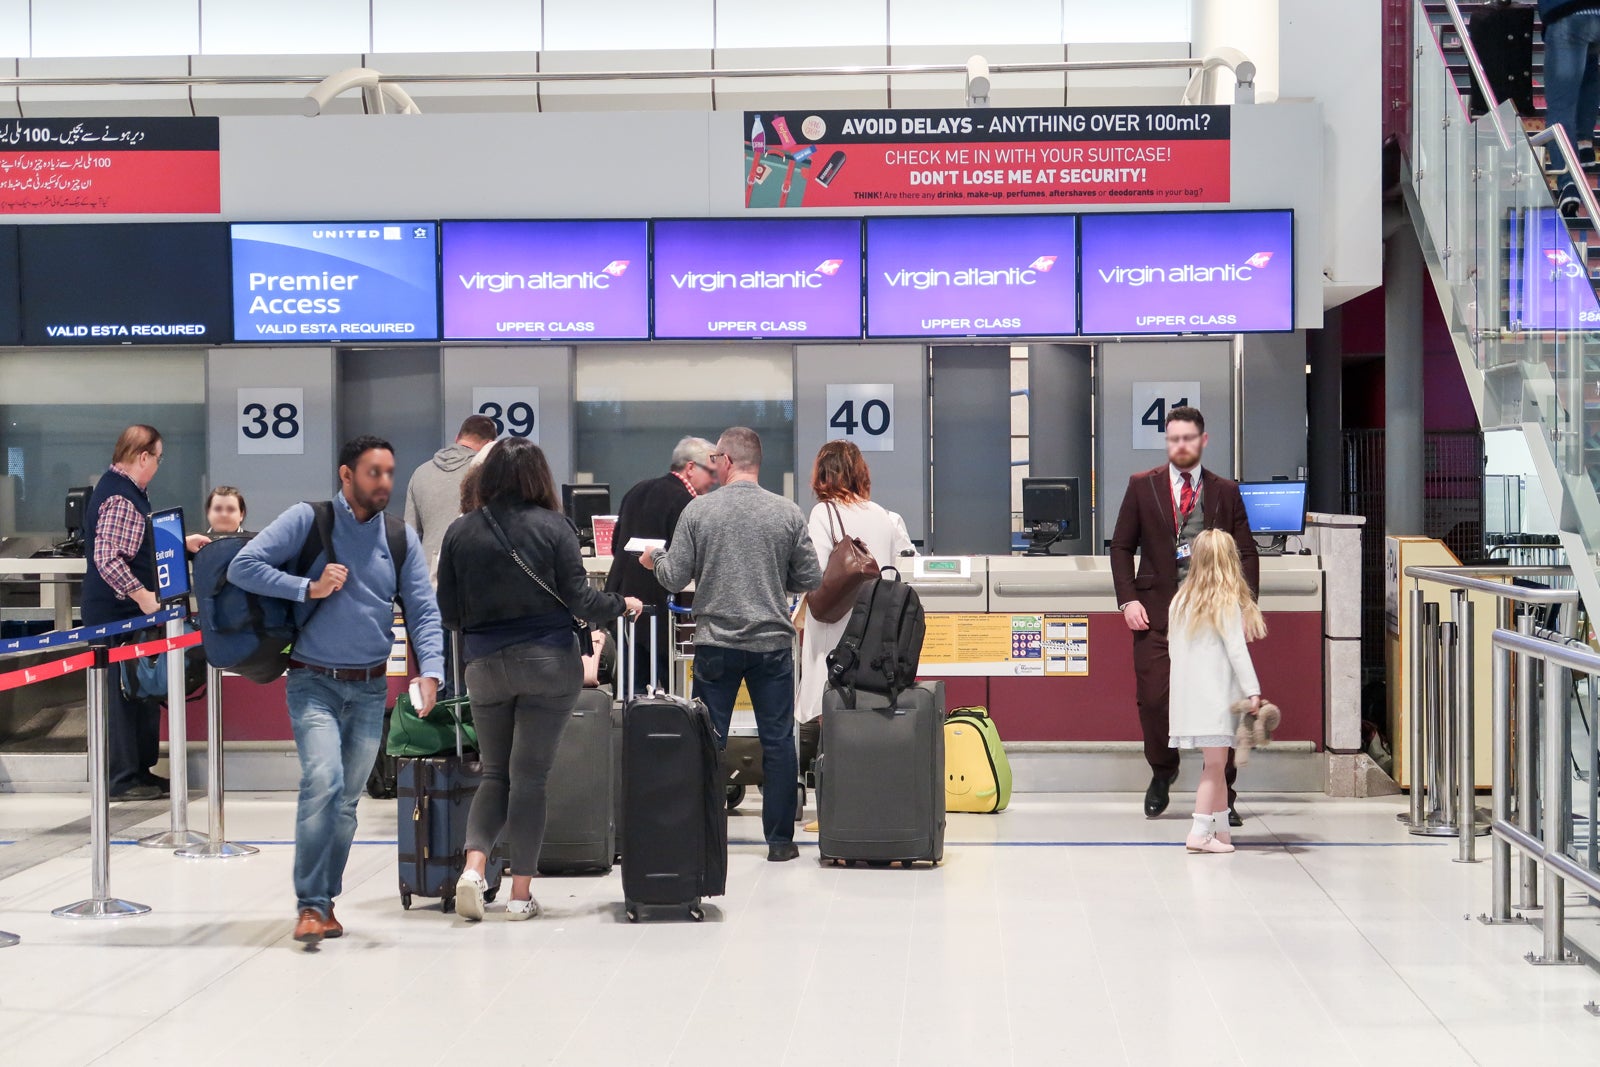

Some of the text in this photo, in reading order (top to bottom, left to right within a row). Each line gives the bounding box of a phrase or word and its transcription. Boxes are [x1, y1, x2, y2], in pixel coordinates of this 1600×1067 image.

[842, 118, 897, 135] AVOID
[901, 117, 973, 135] DELAYS
[988, 115, 1086, 133] ANYTHING
[1090, 114, 1140, 132] OVER
[1145, 113, 1211, 131] 100ml?
[23, 128, 50, 142] 100
[93, 157, 111, 168] 100
[885, 147, 1171, 165] CHECK ME IN WITH YOUR SUITCASE!
[910, 168, 1146, 185] DON'T LOSE ME AT SECURITY!
[853, 191, 882, 200] THINK!
[884, 191, 898, 199] Are
[899, 191, 920, 199] there
[921, 192, 935, 201] any
[1049, 188, 1096, 198] aftershaves
[1098, 190, 1107, 198] or
[1108, 188, 1154, 197] deodorants
[1156, 188, 1164, 197] in
[1165, 189, 1182, 199] your
[1184, 187, 1204, 198] bag?
[312, 230, 380, 239] UNITED
[249, 271, 359, 291] Premier
[459, 271, 610, 293] virgin atlantic
[671, 270, 822, 292] virgin atlantic
[884, 267, 1037, 290] virgin atlantic
[1098, 263, 1253, 286] virgin atlantic
[248, 296, 341, 314] Access
[256, 322, 415, 334] VALID ESTA REQUIRED
[496, 321, 595, 332] UPPER CLASS
[708, 320, 807, 331] UPPER CLASS
[921, 318, 1021, 329] UPPER CLASS
[1136, 314, 1237, 326] UPPER CLASS
[47, 324, 206, 337] VALID ESTA REQUIRED
[242, 403, 301, 440] 38
[479, 402, 535, 438] 39
[829, 400, 891, 435] 40
